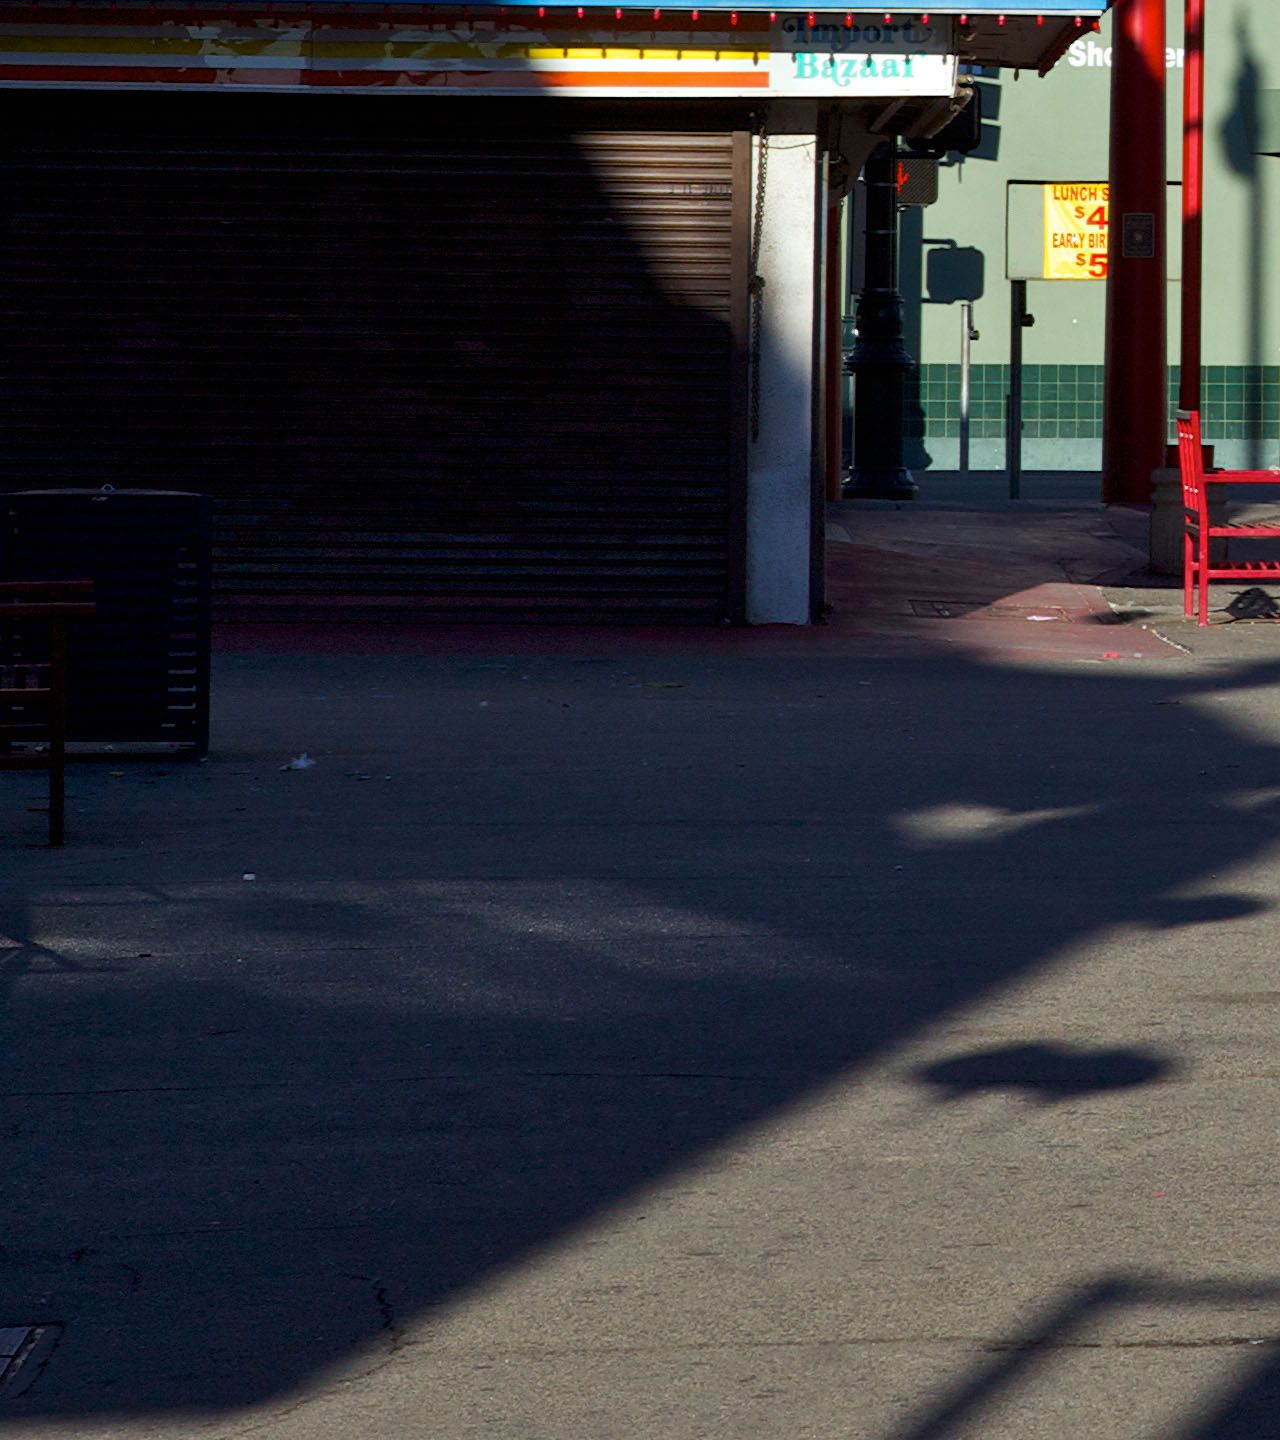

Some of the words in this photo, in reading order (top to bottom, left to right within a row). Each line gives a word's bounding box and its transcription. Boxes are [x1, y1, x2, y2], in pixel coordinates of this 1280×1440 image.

[782, 15, 936, 52] Import
[793, 51, 928, 87] Bazaar
[1053, 186, 1098, 201] LUNCH
[1052, 232, 1085, 249] EARLY
[1088, 232, 1108, 249] BIR
